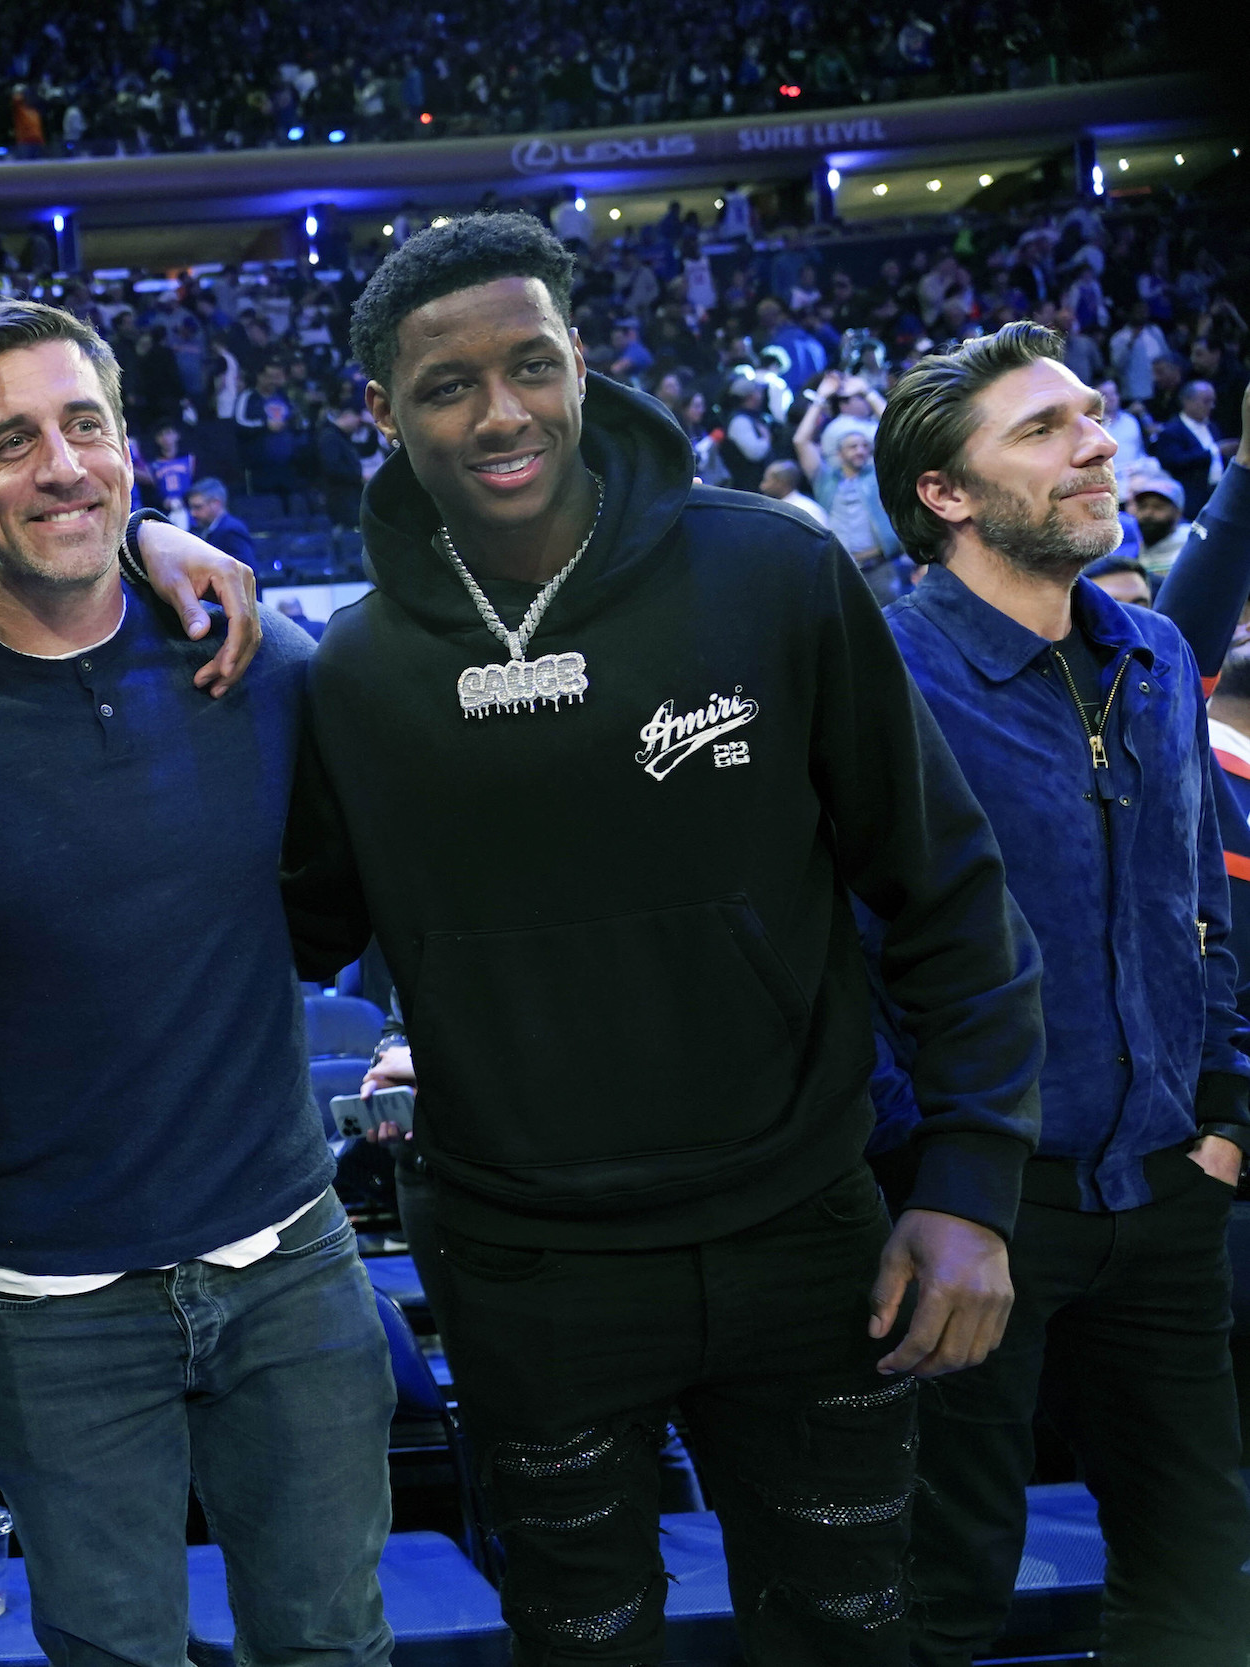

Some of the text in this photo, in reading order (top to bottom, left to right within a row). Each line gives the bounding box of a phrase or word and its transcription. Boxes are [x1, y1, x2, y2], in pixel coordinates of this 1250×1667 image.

[561, 119, 886, 164] LEXUS SUITE LEVEL
[635, 685, 759, 770] Amiri
